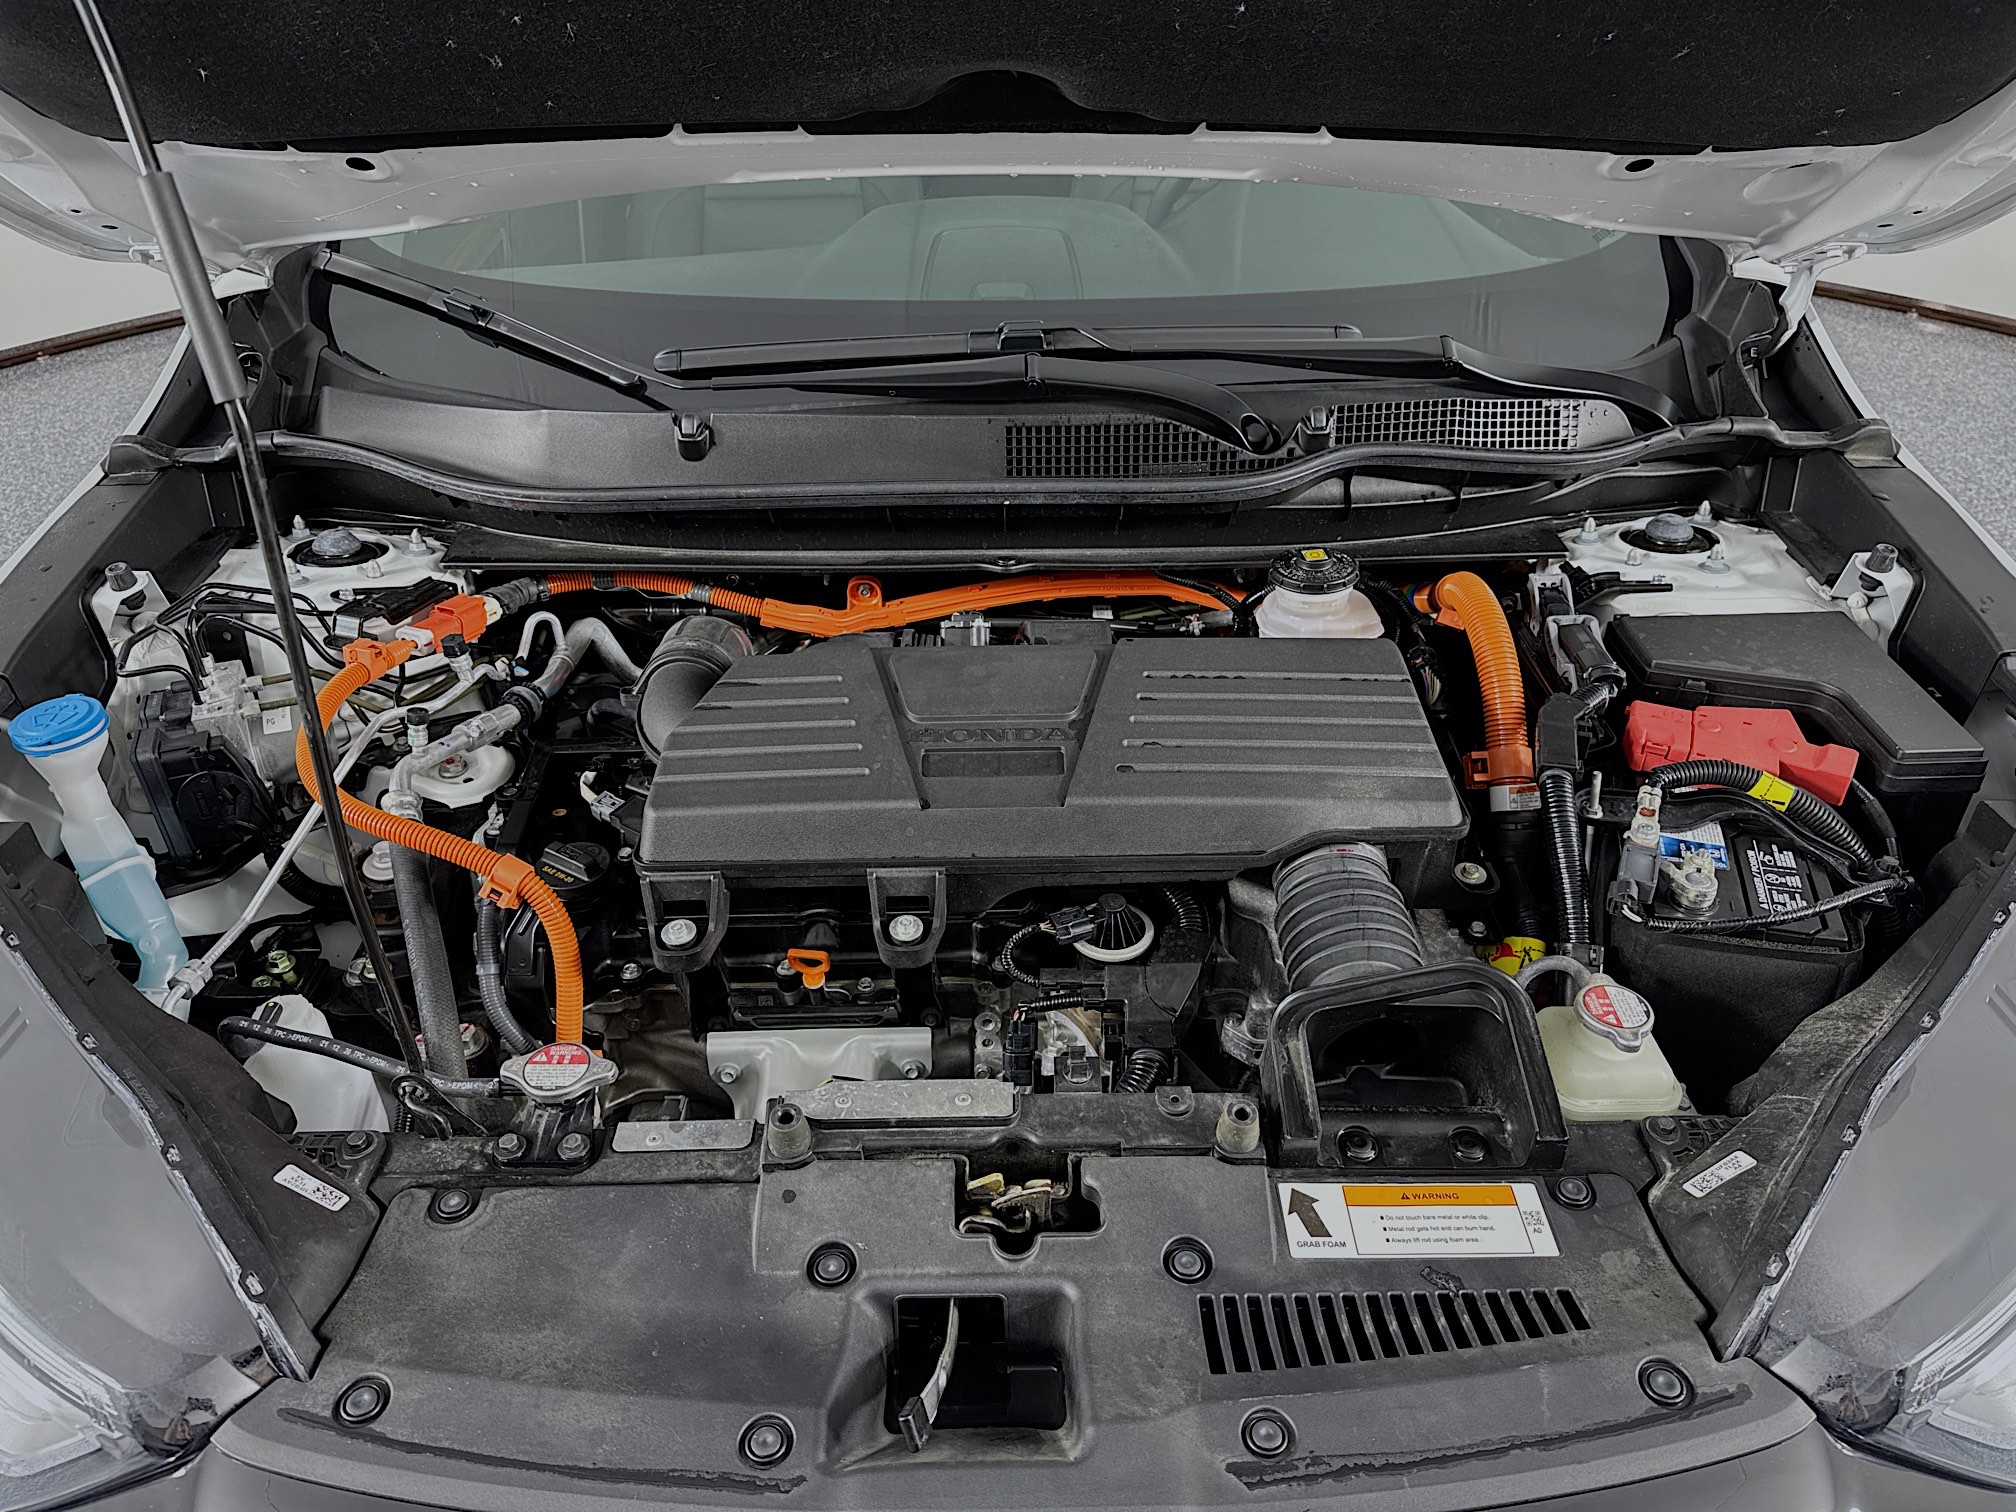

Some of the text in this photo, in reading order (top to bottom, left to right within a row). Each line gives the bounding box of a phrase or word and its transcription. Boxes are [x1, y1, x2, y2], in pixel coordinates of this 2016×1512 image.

[908, 728, 1079, 744] HONDA
[542, 865, 557, 875] SAE
[1746, 850, 1760, 872] POISON
[1754, 877, 1768, 902] DANGER
[274, 1029, 287, 1039] TPC
[353, 1050, 366, 1060] TPC
